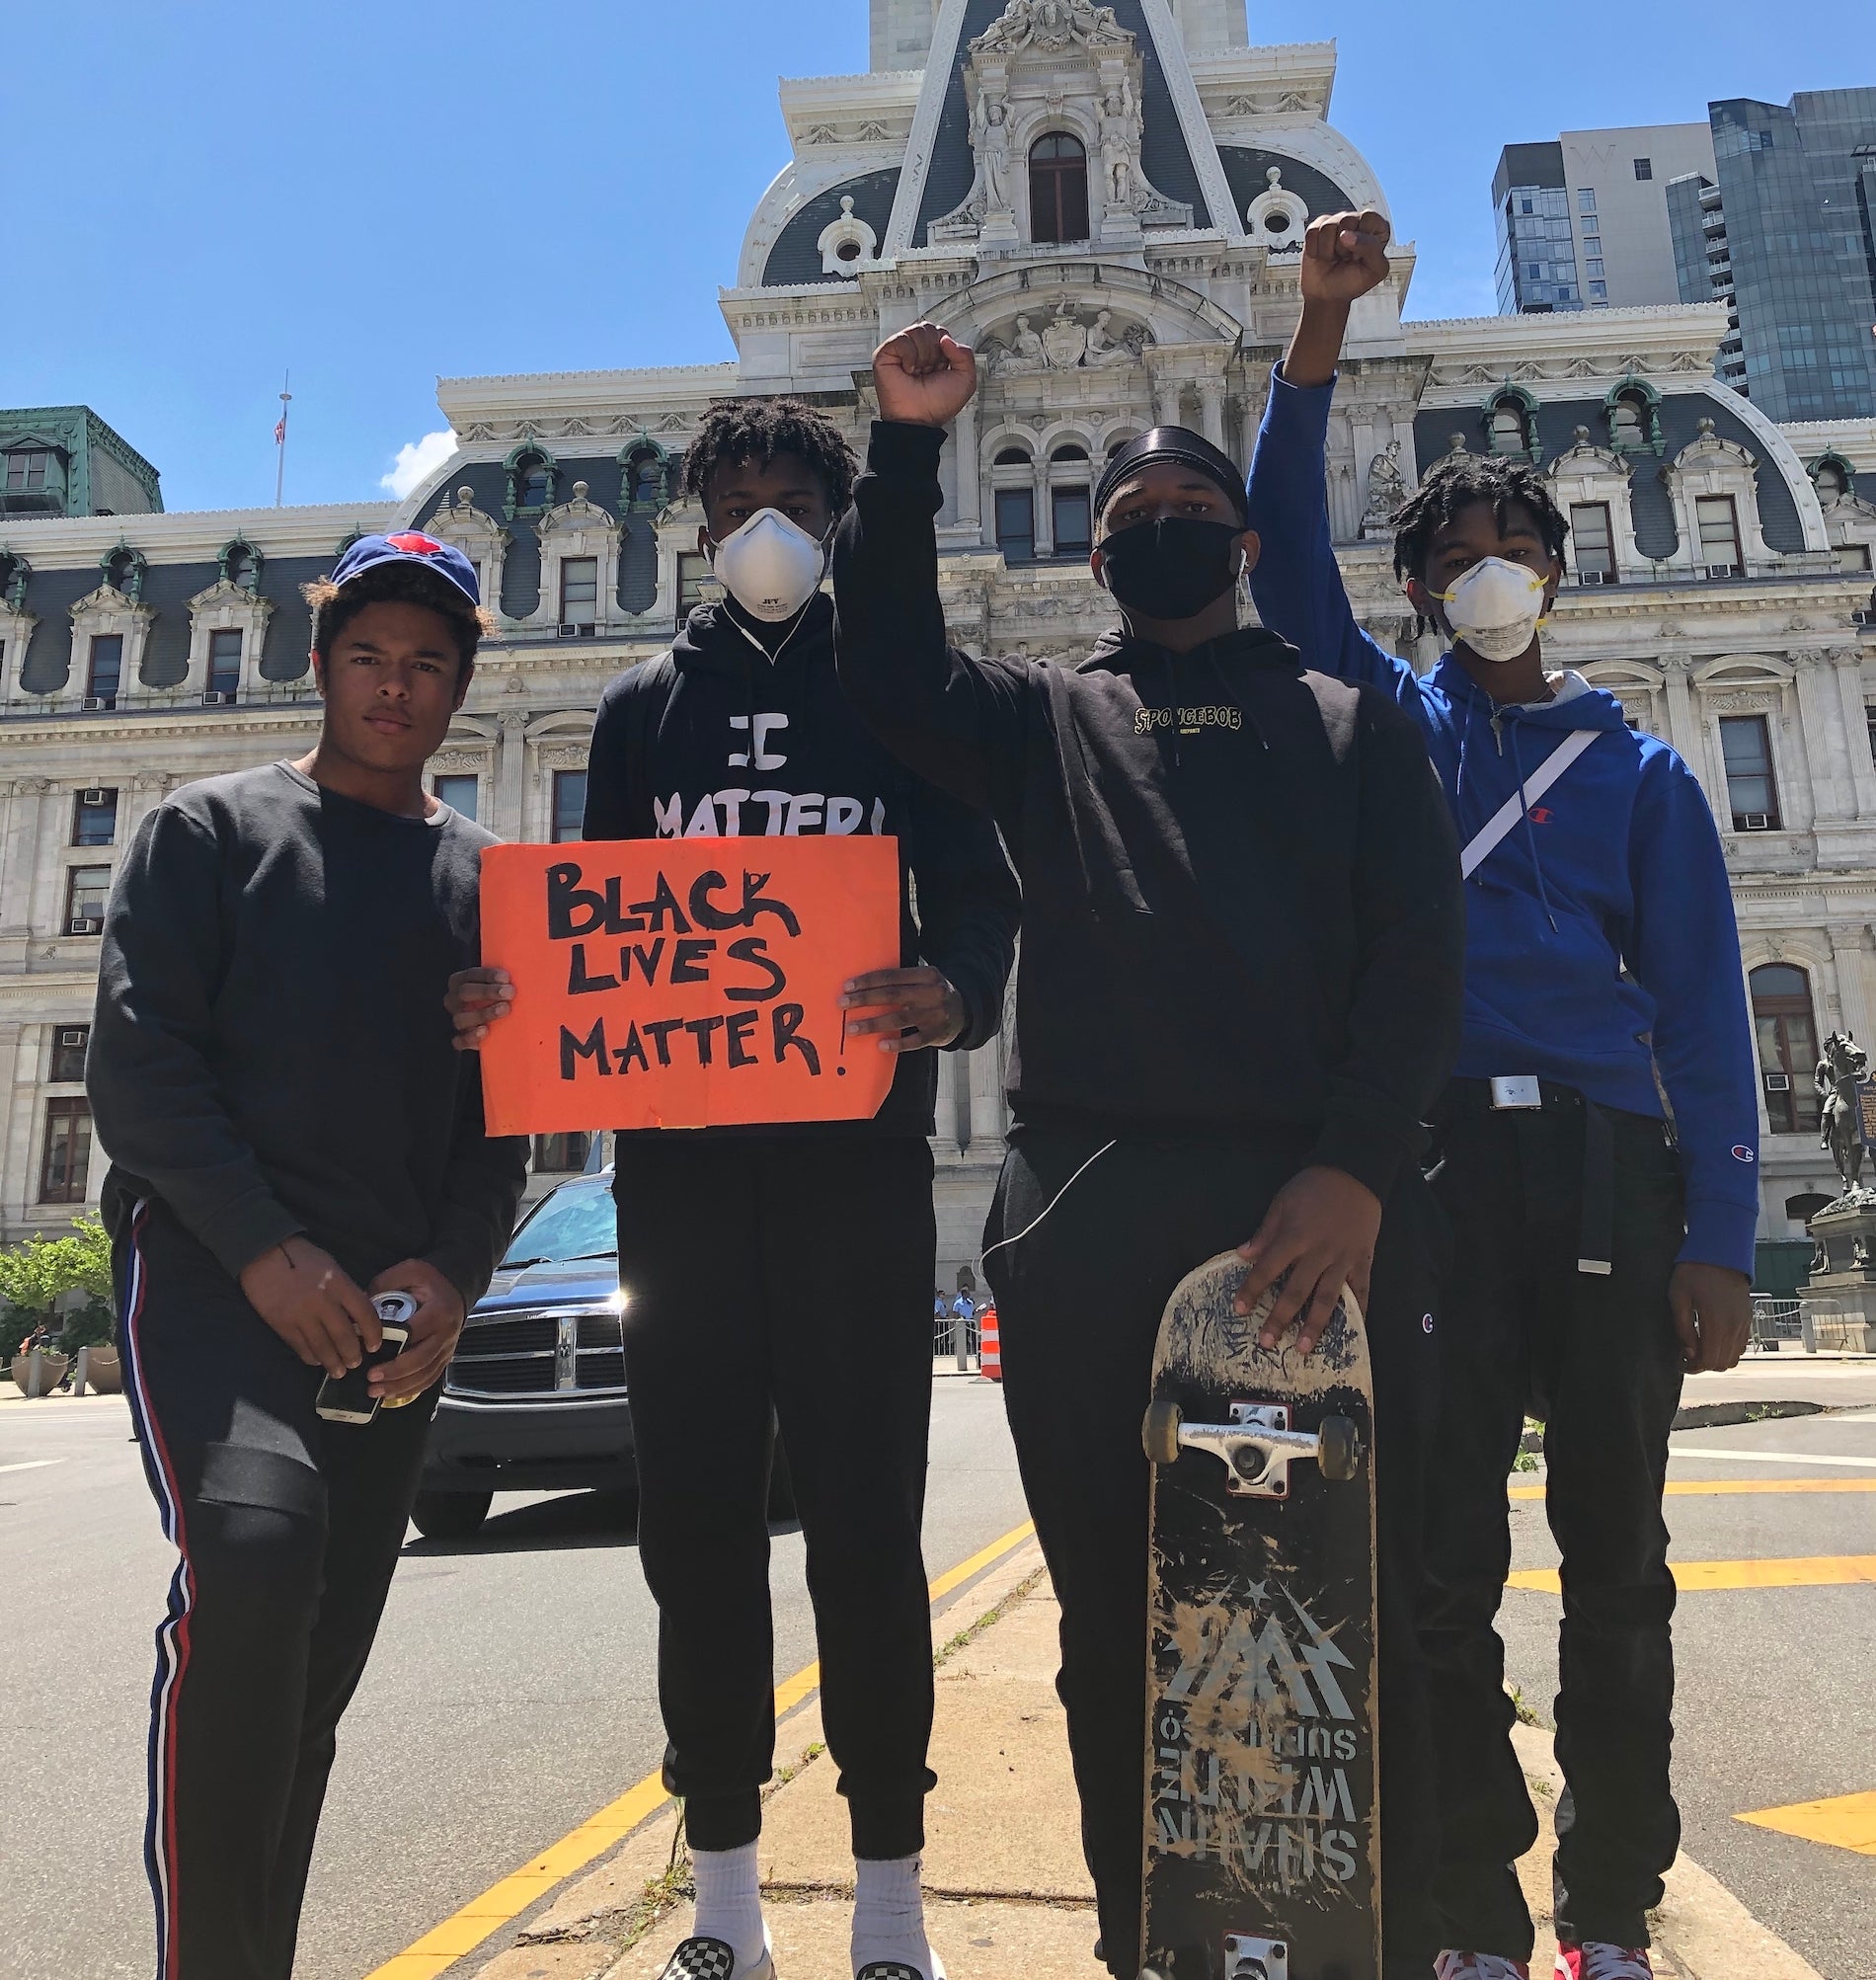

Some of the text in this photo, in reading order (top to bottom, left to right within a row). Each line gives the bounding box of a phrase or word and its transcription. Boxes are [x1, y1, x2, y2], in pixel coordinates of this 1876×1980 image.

[728, 712, 789, 770] I
[545, 862, 801, 939] BLACK
[568, 937, 786, 1002] LIVES
[560, 1003, 847, 1080] MATTER!
